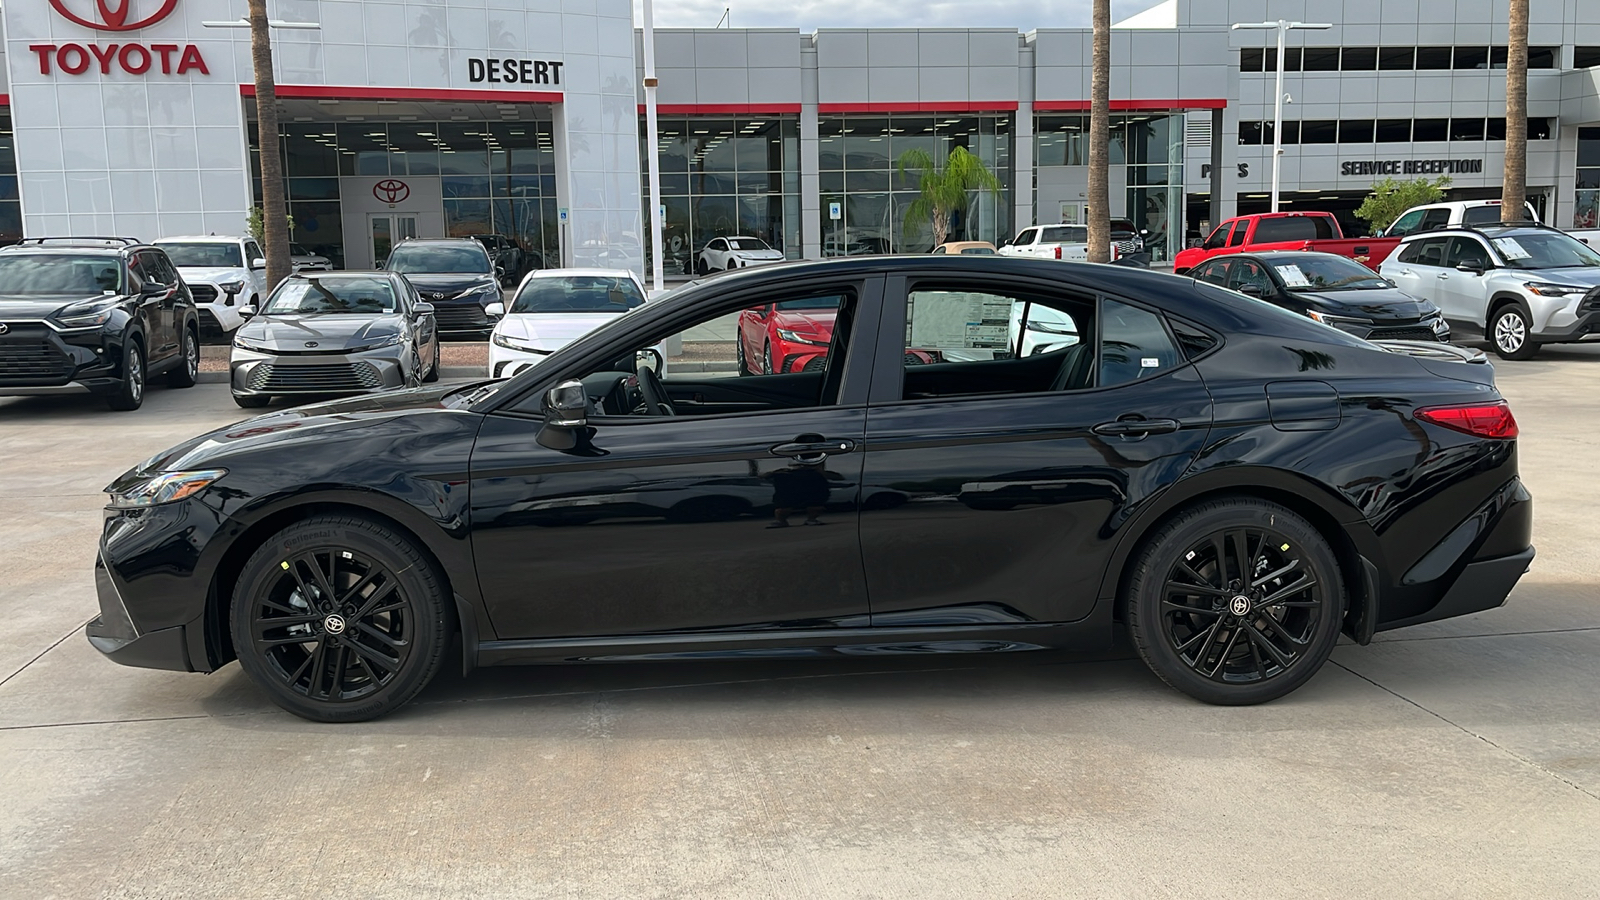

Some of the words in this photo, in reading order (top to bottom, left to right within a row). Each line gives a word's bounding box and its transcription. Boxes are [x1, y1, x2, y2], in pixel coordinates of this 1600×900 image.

[29, 43, 210, 75] TOYOTA
[468, 58, 564, 85] DESERT
[1341, 160, 1401, 176] SERVICE
[1402, 159, 1483, 174] RECEPTION
